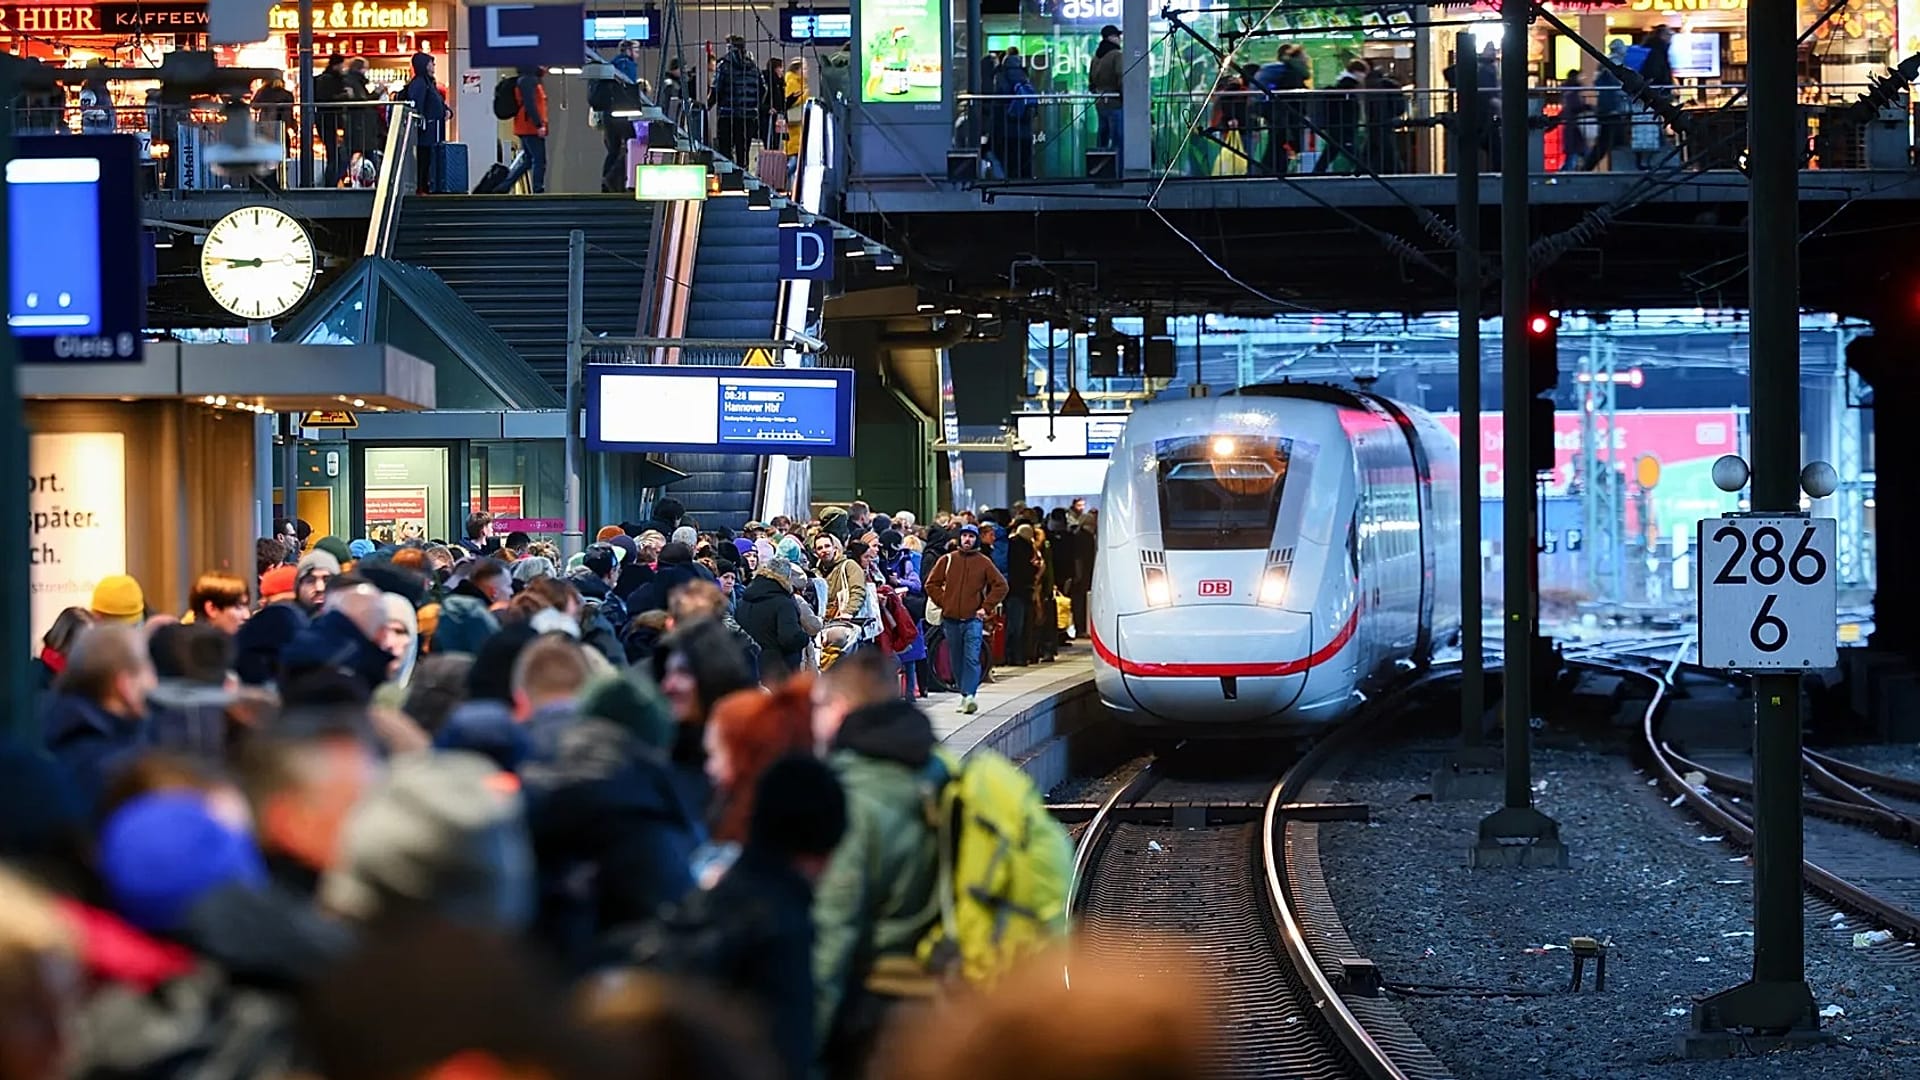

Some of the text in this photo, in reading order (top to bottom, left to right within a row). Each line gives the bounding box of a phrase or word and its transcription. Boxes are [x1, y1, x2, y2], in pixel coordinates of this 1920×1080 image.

[16, 8, 96, 31] HIER
[116, 12, 210, 25] KAFFEEW
[269, 1, 429, 28] fraz & friends
[183, 145, 193, 189] Abfall
[796, 231, 824, 271] D
[54, 333, 114, 358] Gleis
[724, 401, 764, 413] Hannover
[1712, 526, 1827, 585] 286
[1202, 583, 1228, 593] DB
[1750, 594, 1788, 652] 6
